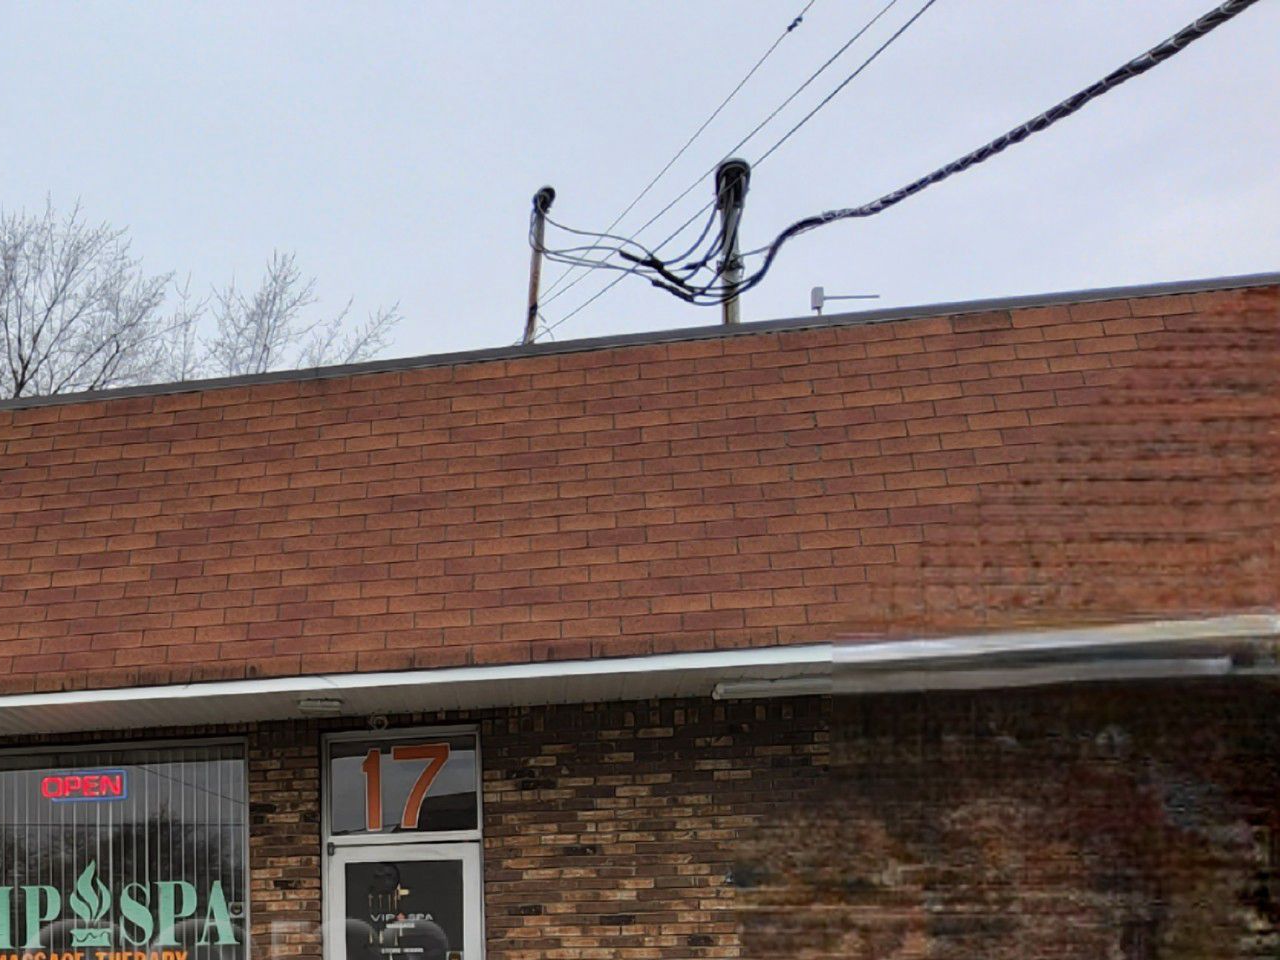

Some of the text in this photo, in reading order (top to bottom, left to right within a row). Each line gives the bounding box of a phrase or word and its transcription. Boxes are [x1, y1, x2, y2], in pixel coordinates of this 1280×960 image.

[41, 775, 122, 798] OPEN
[361, 743, 450, 831] 17
[119, 880, 240, 947] SPA
[370, 913, 396, 922] VIP
